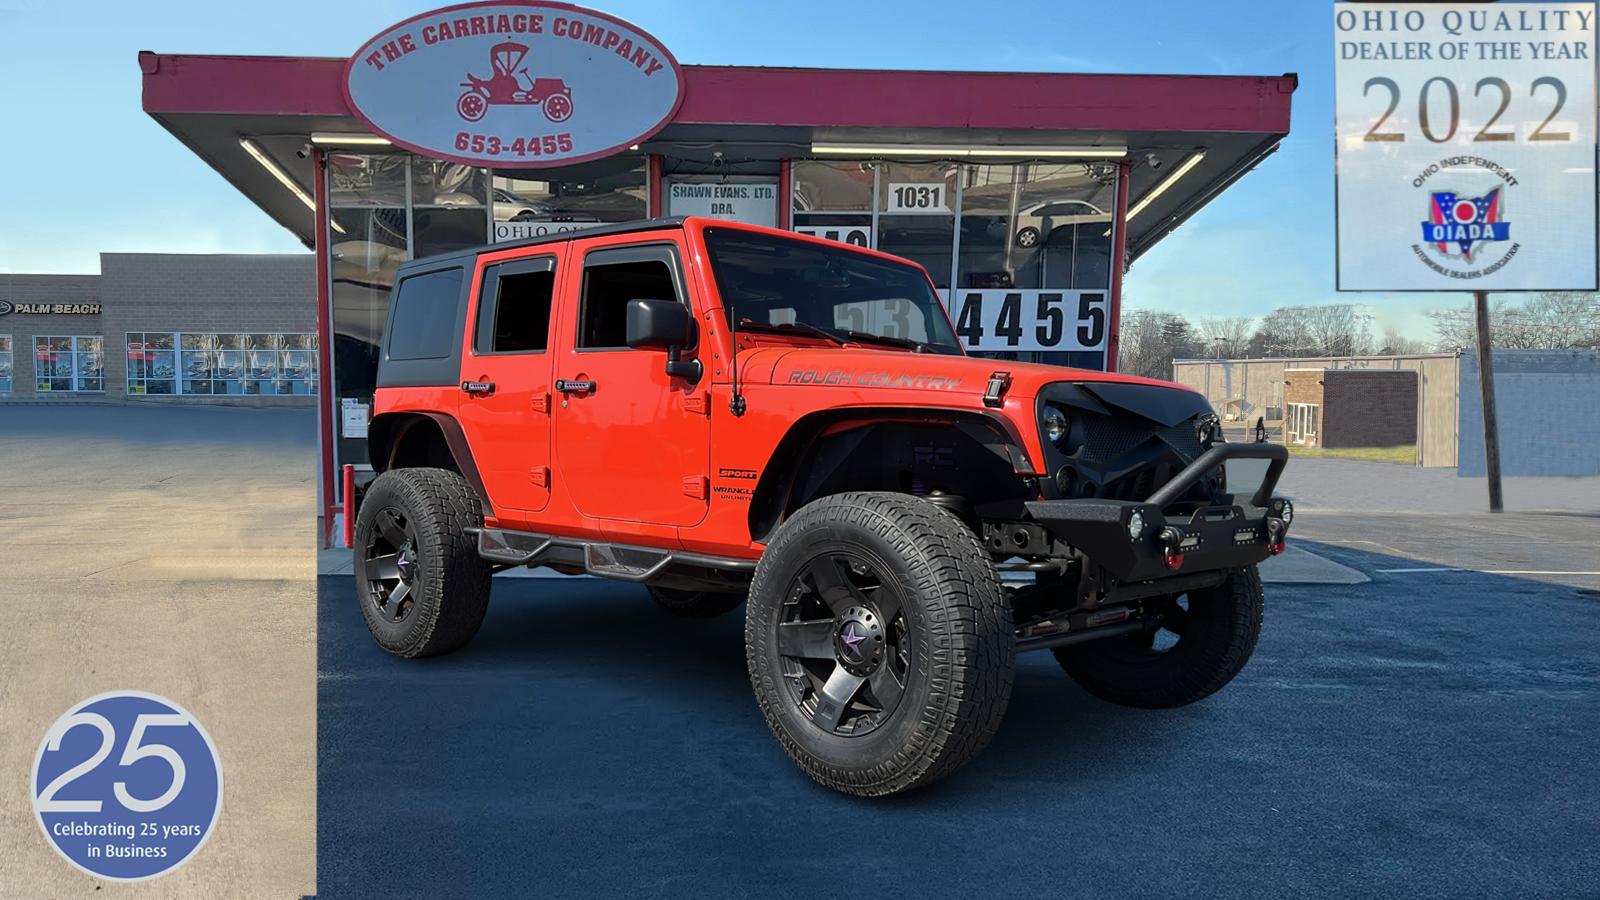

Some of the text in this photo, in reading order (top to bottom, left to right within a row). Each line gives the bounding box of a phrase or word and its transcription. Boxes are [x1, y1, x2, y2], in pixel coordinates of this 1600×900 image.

[1336, 10, 1592, 35] OHIO QUALITY
[365, 14, 663, 77] THE CARRIAGE COMPANY
[1340, 42, 1589, 60] DEALER OF THE YEAR
[1363, 76, 1571, 143] 2022
[455, 132, 573, 157] 653-4455
[1413, 155, 1519, 188] OHIO INDEPENDENT
[673, 186, 711, 198] SHAWN
[895, 187, 941, 208] 1031
[711, 203, 736, 215] DBA.
[497, 226, 548, 238] OHIO
[1432, 224, 1495, 240] OIADA
[1411, 242, 1521, 279] AUTOMOBILE DEALERS ASSOCIATION
[15, 304, 51, 314] PALM
[54, 304, 100, 314] BEACH
[957, 293, 1105, 347] 4455
[789, 370, 961, 390] ROUGH COUNTRY
[720, 469, 757, 478] SPORT
